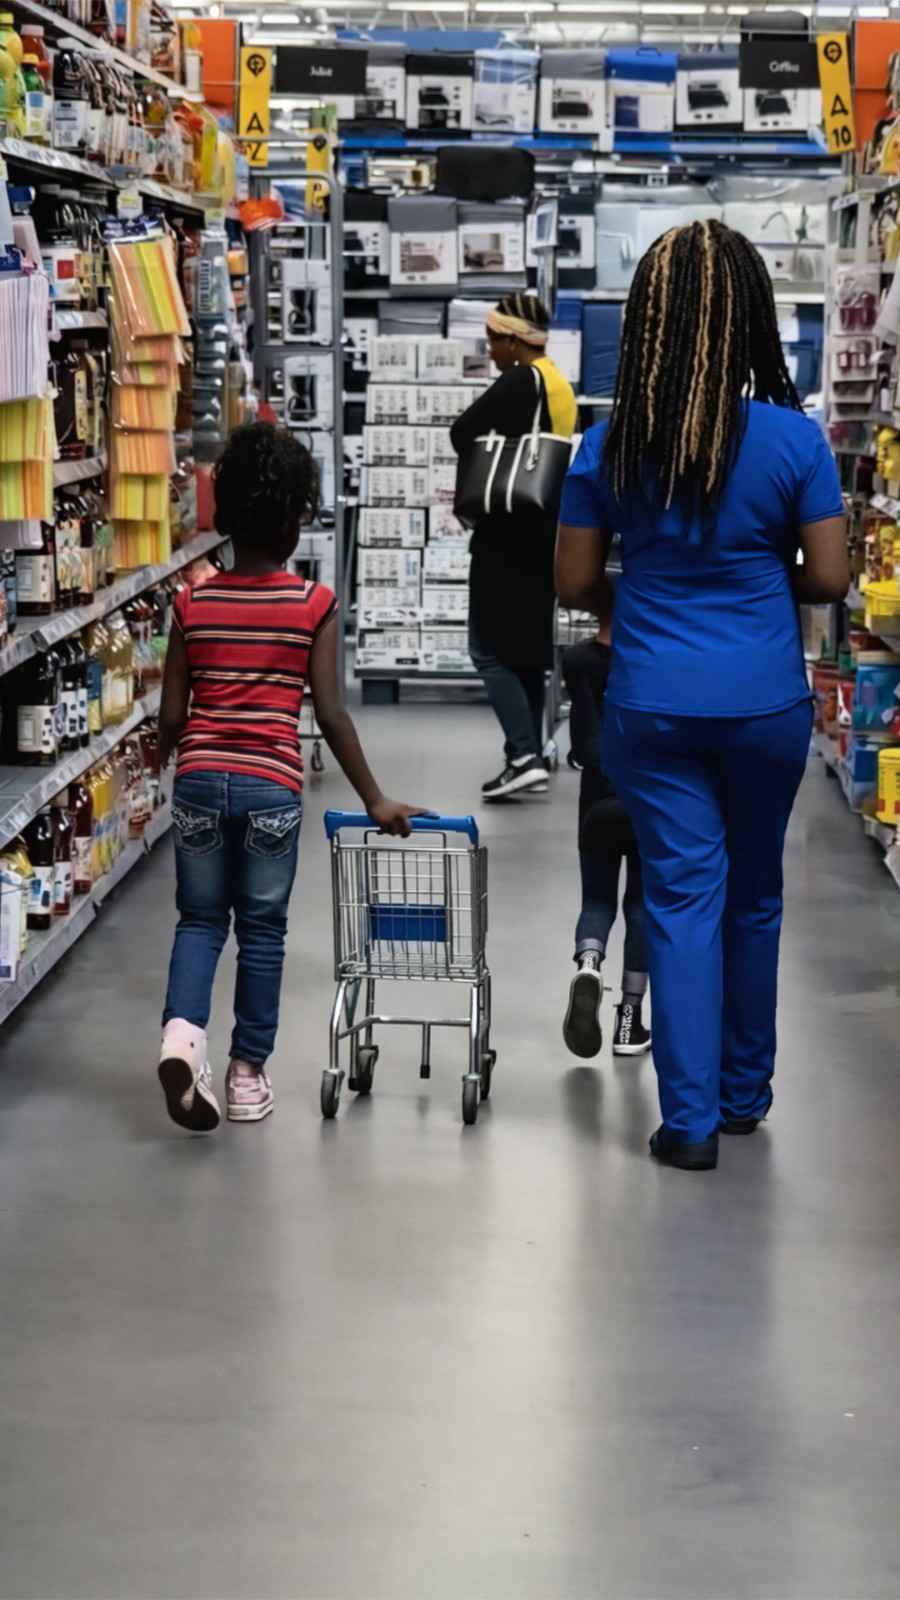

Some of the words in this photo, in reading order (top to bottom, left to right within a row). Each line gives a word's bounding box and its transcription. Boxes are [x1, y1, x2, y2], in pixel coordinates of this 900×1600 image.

[831, 93, 849, 116] A
[246, 111, 265, 134] A
[832, 125, 852, 149] 10
